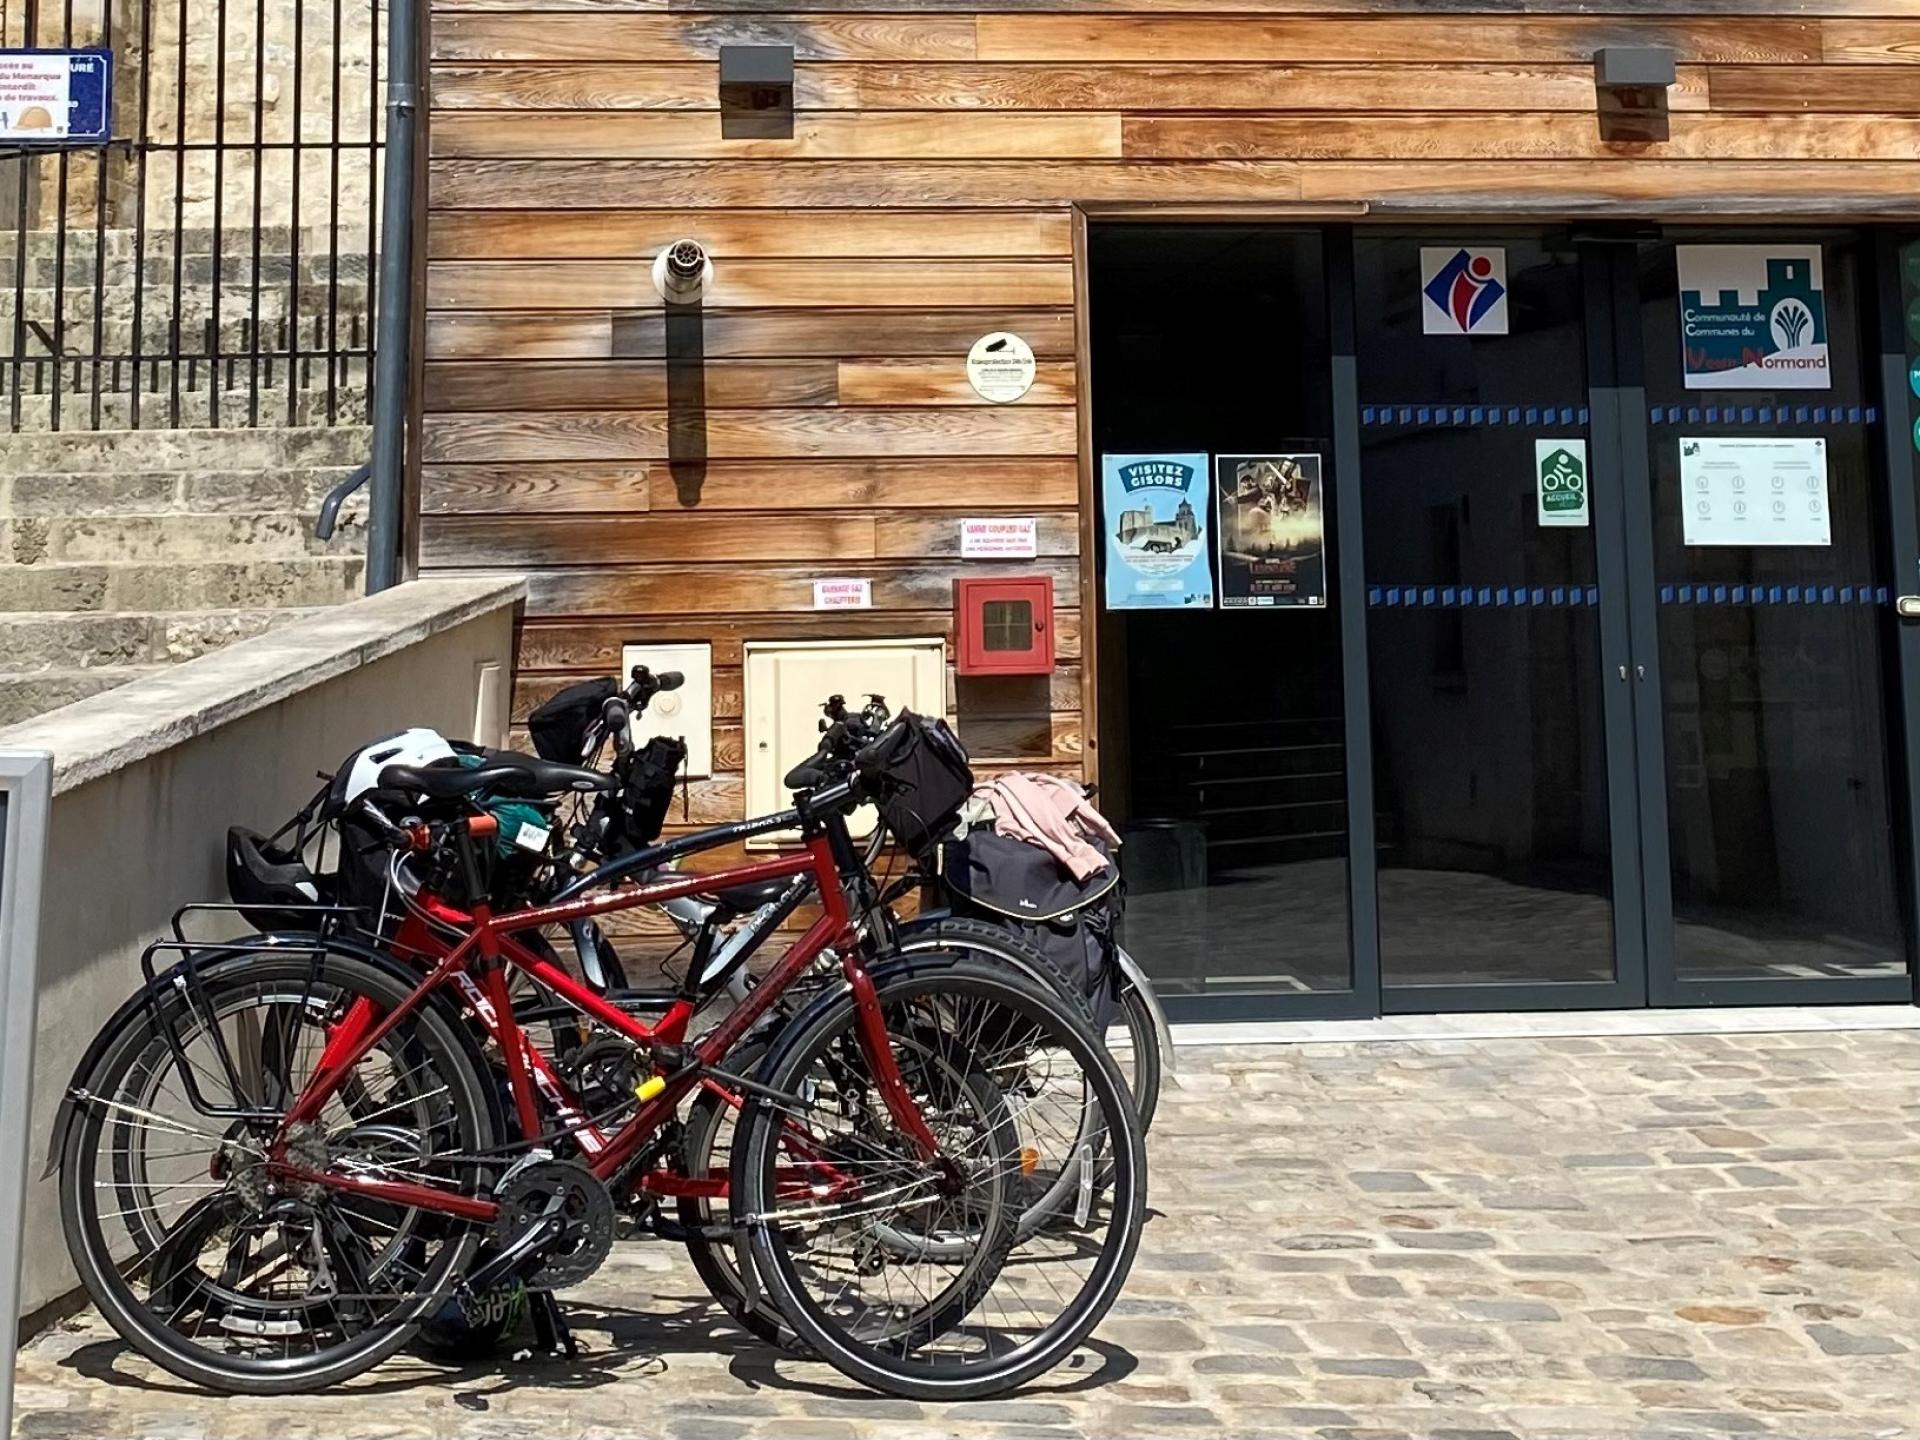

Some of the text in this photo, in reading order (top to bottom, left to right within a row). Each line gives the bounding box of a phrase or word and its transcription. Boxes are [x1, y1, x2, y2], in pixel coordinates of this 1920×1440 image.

[1684, 308, 1766, 322] Communauté de
[1685, 323, 1755, 336] Communes du
[1742, 348, 1826, 369] Normand
[1128, 463, 1184, 477] VISITEZ
[1130, 475, 1183, 487] GISORS
